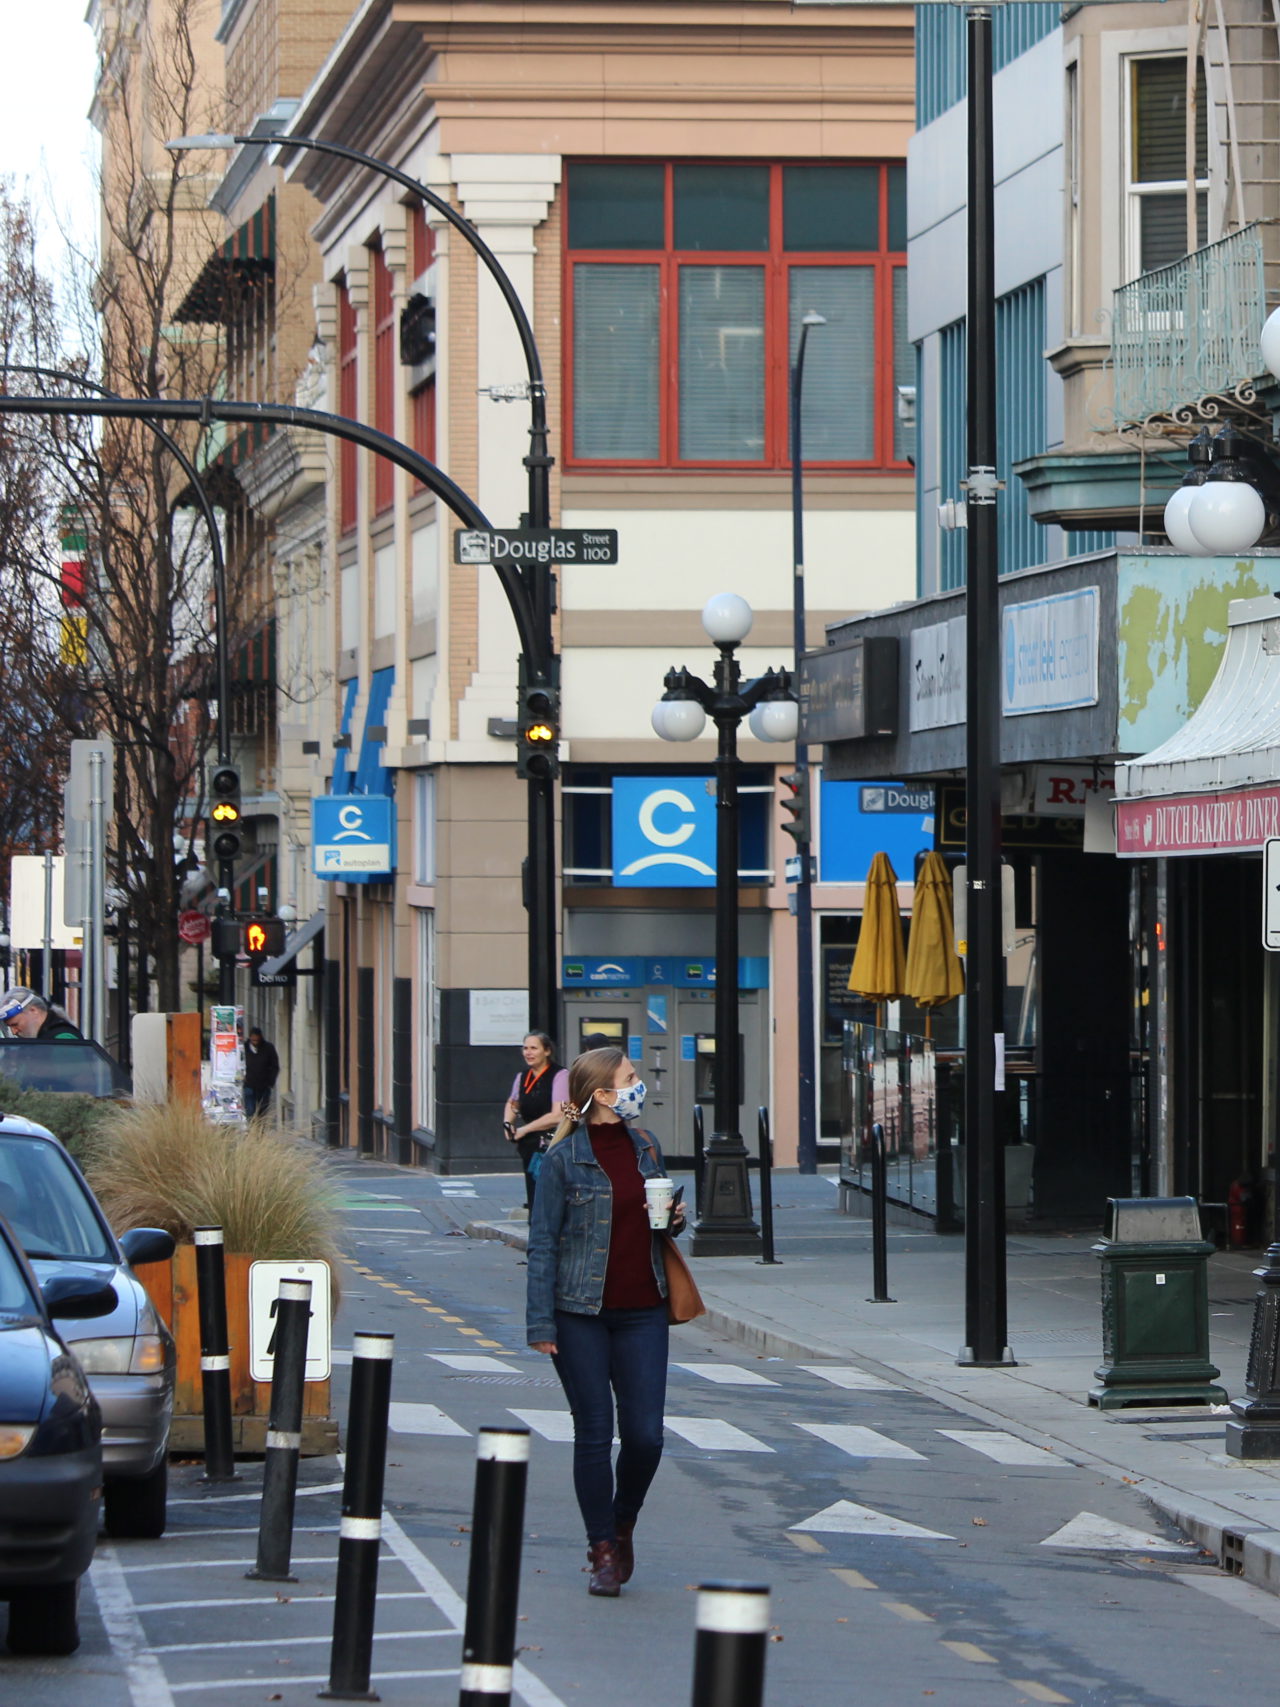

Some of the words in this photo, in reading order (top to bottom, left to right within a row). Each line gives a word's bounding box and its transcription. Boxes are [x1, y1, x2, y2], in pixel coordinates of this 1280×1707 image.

[582, 533, 610, 544] Street
[494, 535, 576, 562] Douglas
[583, 548, 611, 560] 1100
[887, 790, 935, 809] Dougl
[1156, 805, 1190, 846] DUTCH
[1192, 800, 1235, 844] BAKERY
[1235, 800, 1244, 841] &
[1246, 796, 1280, 840] DINER
